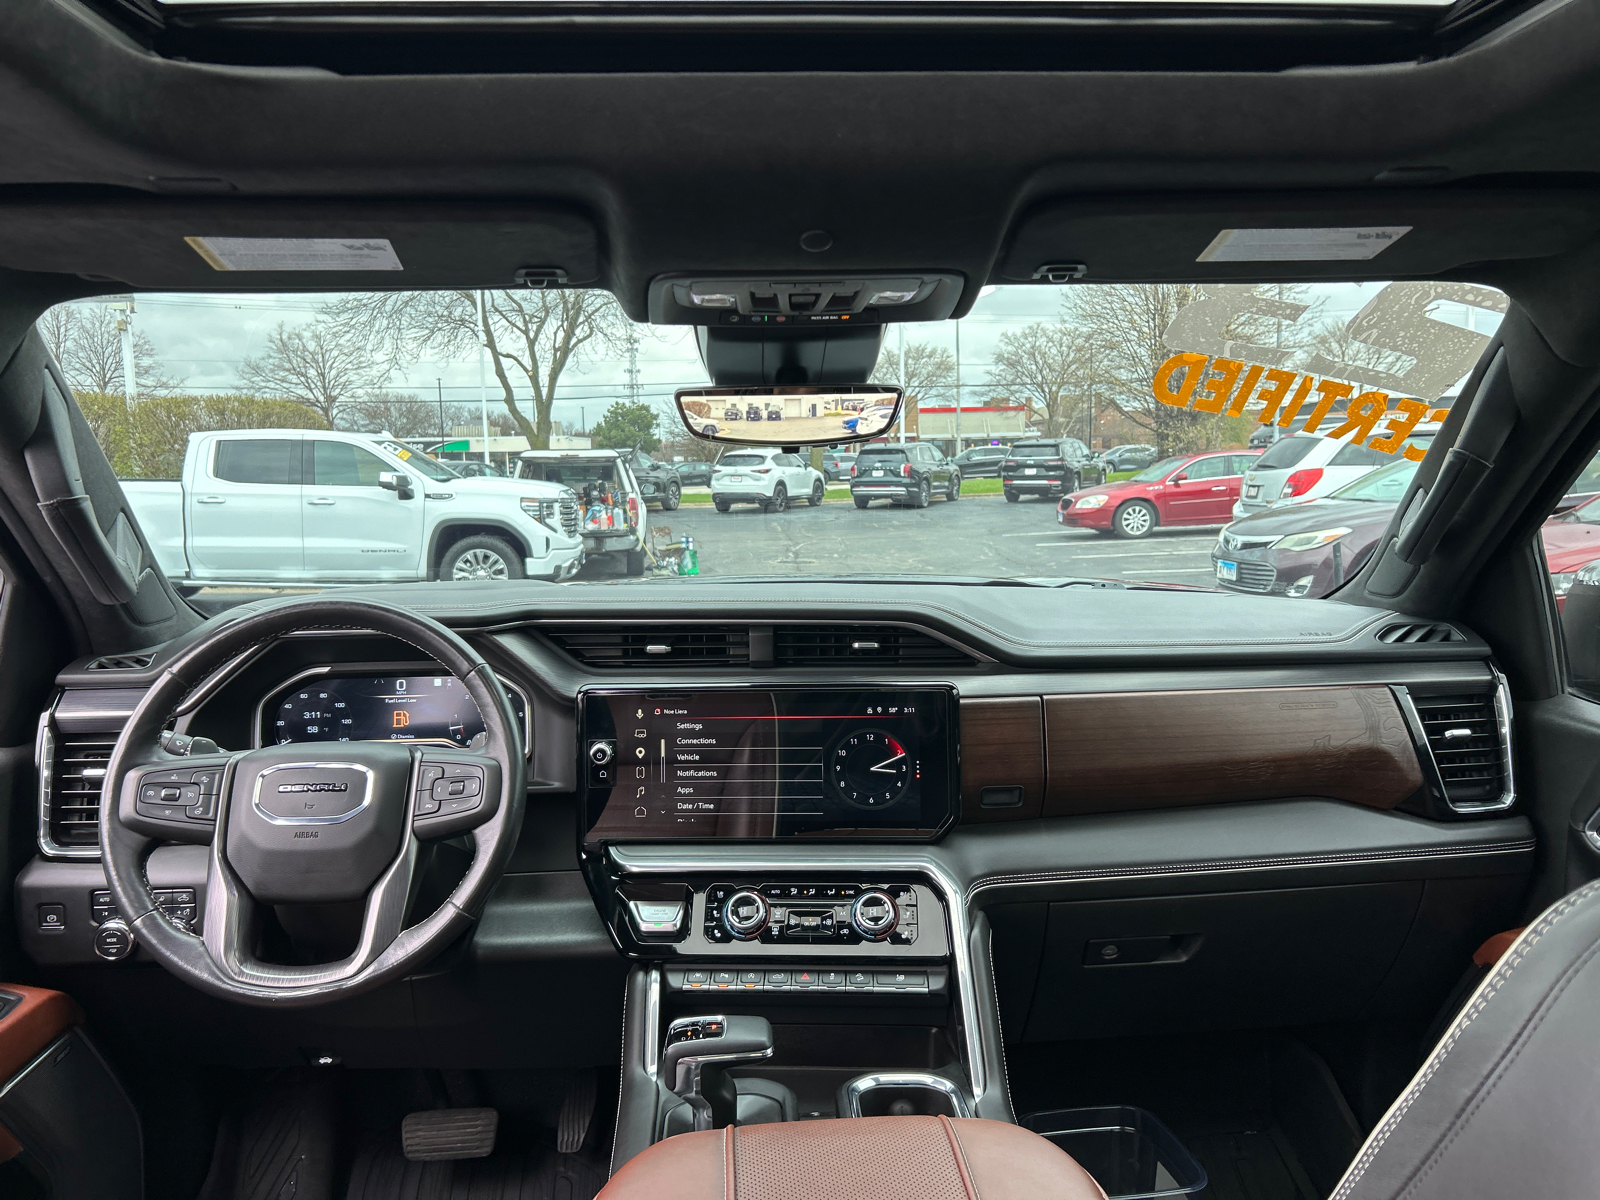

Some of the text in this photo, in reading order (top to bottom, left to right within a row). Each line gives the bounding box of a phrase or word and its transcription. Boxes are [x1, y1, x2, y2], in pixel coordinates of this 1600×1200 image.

[396, 679, 406, 691] 0
[303, 711, 321, 719] 3:11
[307, 725, 319, 733] 58
[676, 722, 703, 731] Settings
[676, 753, 700, 761] Vehicle
[278, 782, 349, 793] DENALI
[676, 786, 694, 794] Apps
[293, 831, 320, 839] AIRBAG
